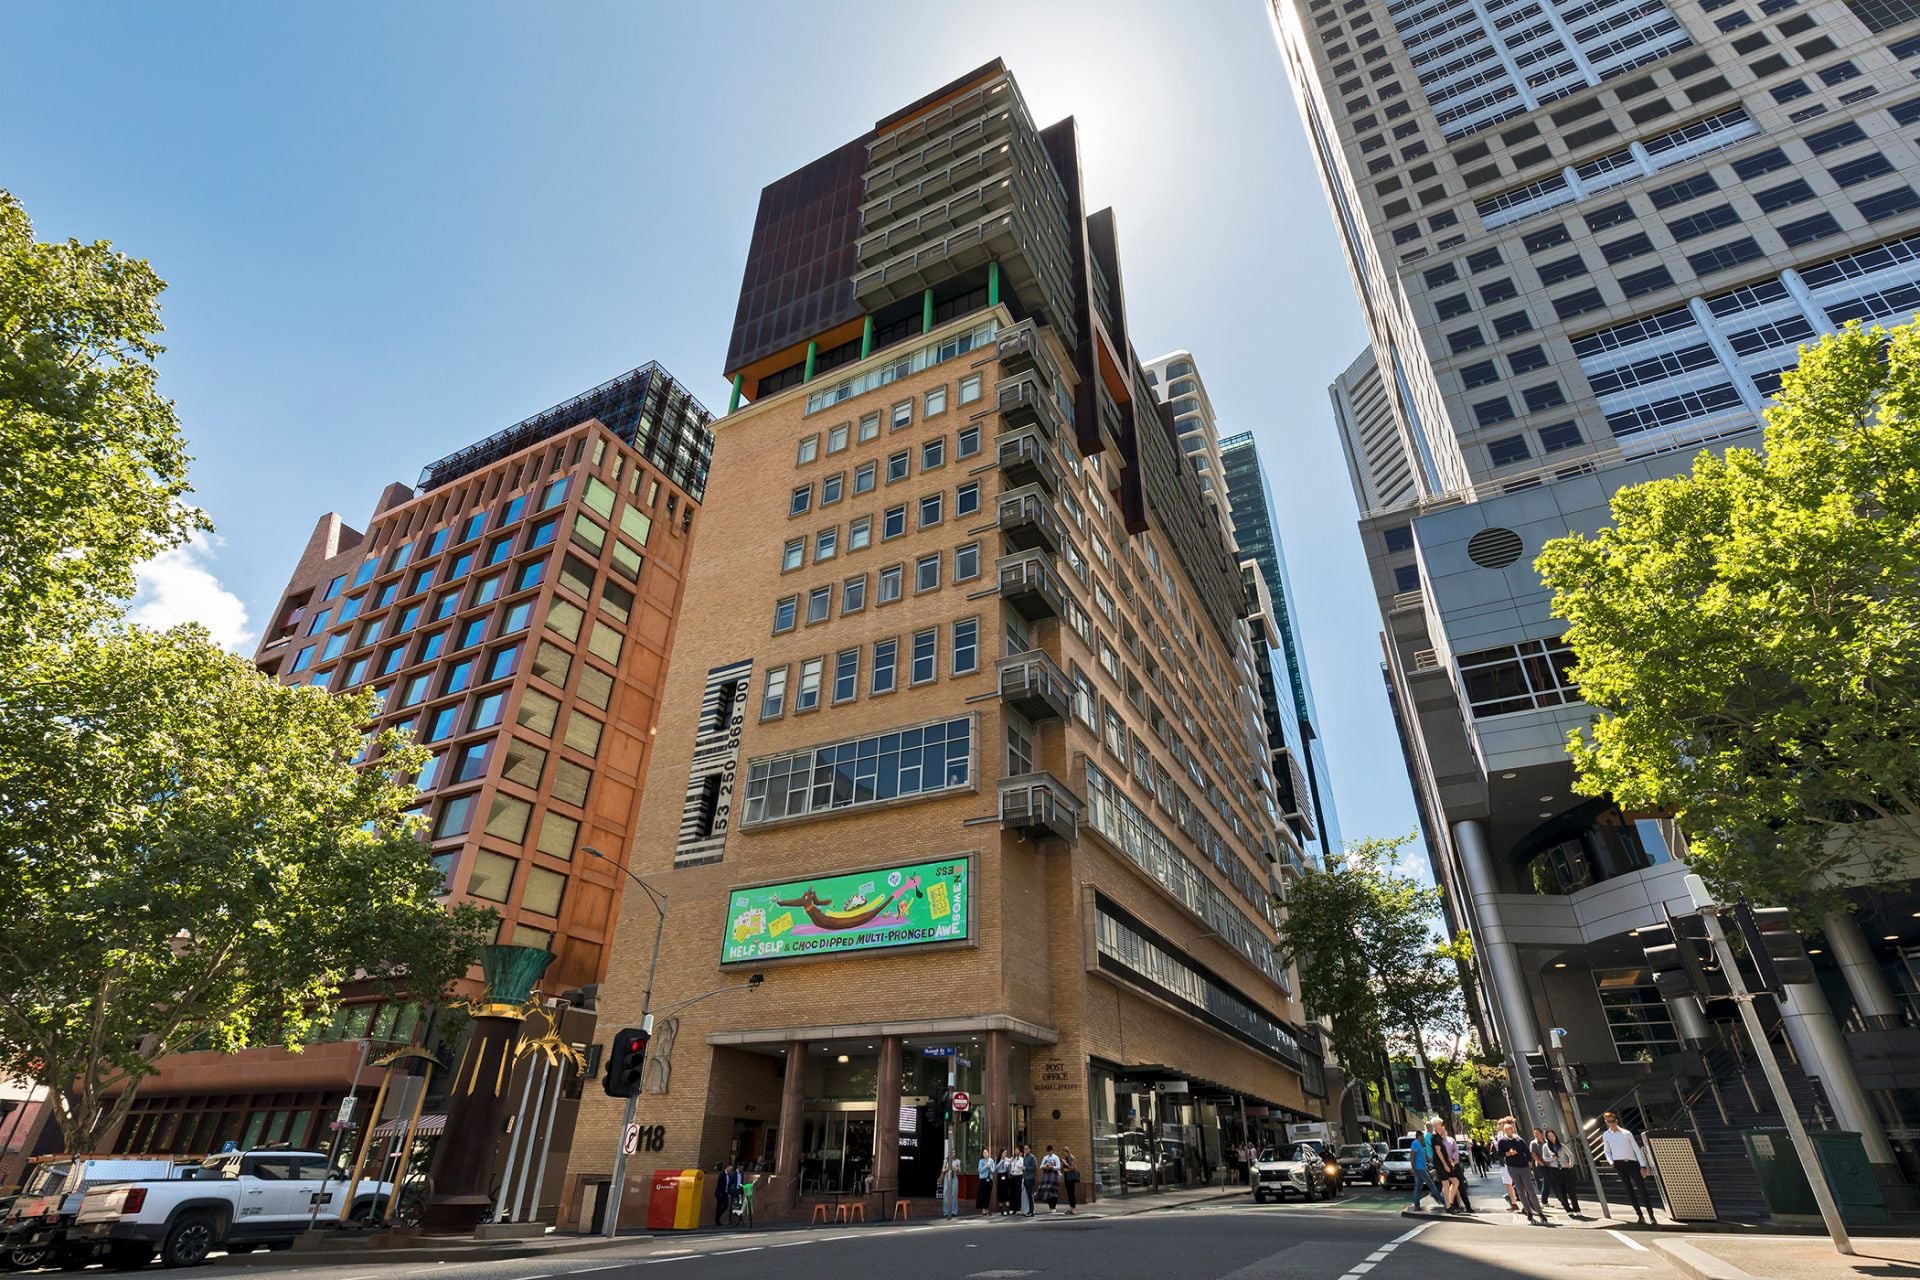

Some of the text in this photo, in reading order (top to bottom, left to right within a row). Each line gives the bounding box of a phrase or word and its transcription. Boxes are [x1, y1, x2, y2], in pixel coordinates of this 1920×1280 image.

[720, 759, 737, 795] 250
[714, 804, 730, 830] 53
[729, 944, 757, 959] HELF
[757, 940, 784, 955] SELP
[784, 944, 791, 952] &
[792, 940, 818, 951] CHOC
[819, 937, 855, 949] DIPPED
[856, 927, 936, 946] MULTI-PRONGED
[1042, 1072, 1069, 1081] OFFICE
[1045, 1063, 1065, 1072] POST
[635, 1124, 666, 1152] 118
